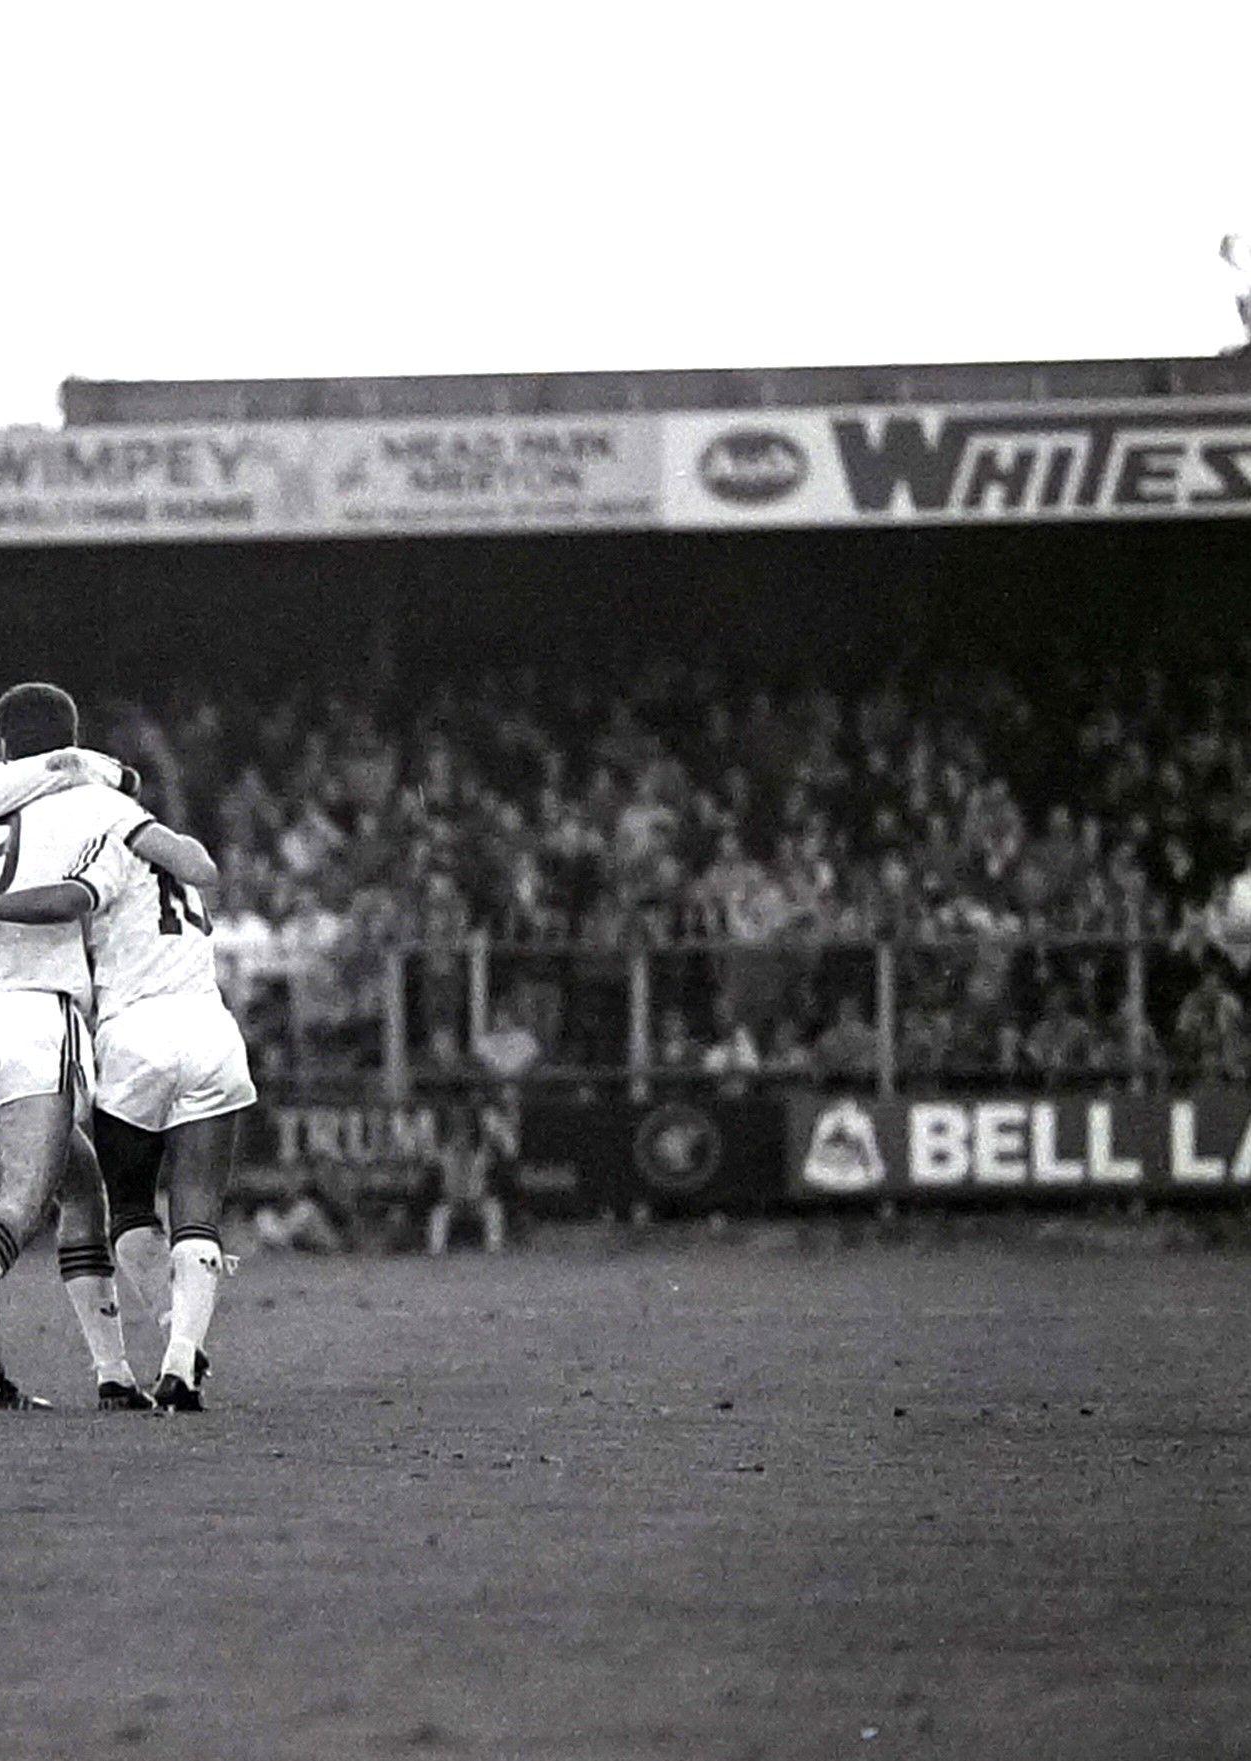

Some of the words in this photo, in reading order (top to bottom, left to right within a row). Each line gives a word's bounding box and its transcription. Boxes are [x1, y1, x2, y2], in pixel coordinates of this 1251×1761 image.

[270, 1107, 521, 1163] TRUMN
[907, 1101, 1143, 1185] BELL
[1170, 1100, 1251, 1184] L
